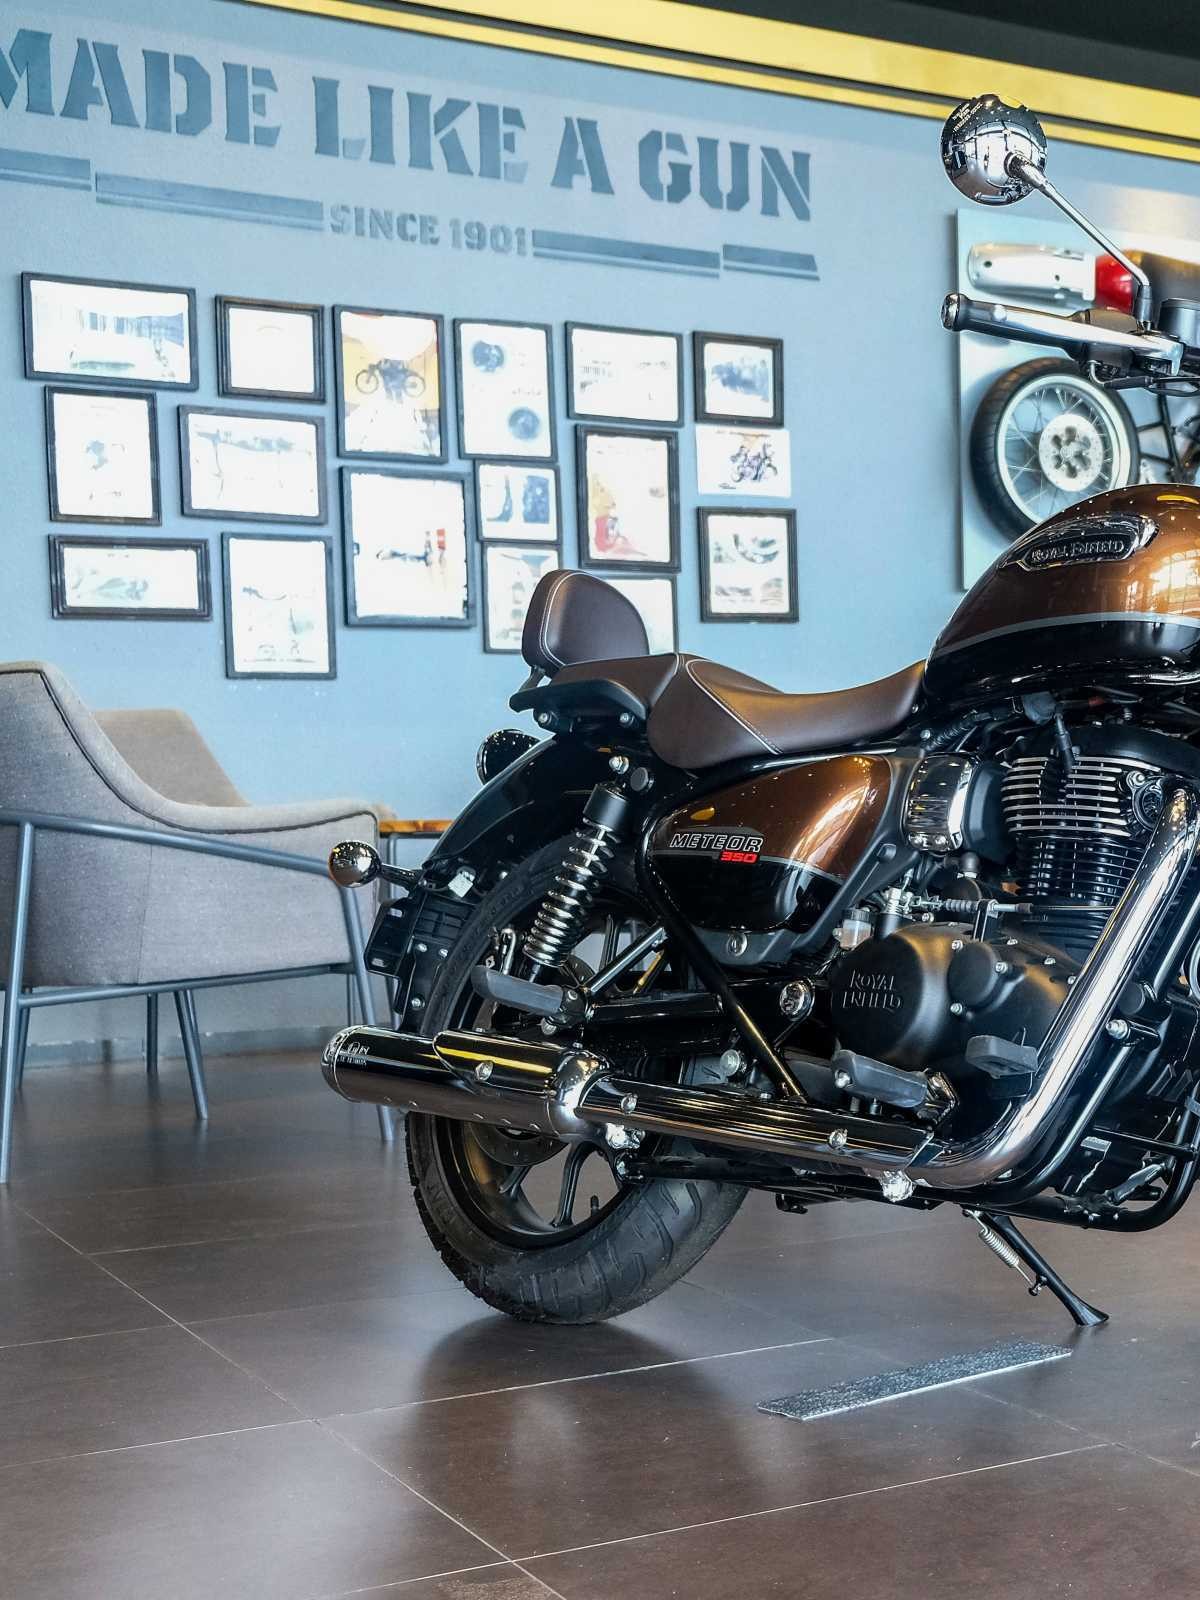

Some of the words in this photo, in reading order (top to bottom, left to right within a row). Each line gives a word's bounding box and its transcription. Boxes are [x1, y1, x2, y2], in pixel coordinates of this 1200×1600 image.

[0, 29, 281, 147] MADE
[312, 76, 528, 183] LIKE
[550, 116, 615, 195] A
[638, 129, 811, 221] GUN
[330, 203, 440, 246] SINCE
[449, 217, 526, 256] 1901
[669, 833, 763, 853] METEOR
[720, 850, 758, 863] 350
[849, 969, 897, 991] ROYAL
